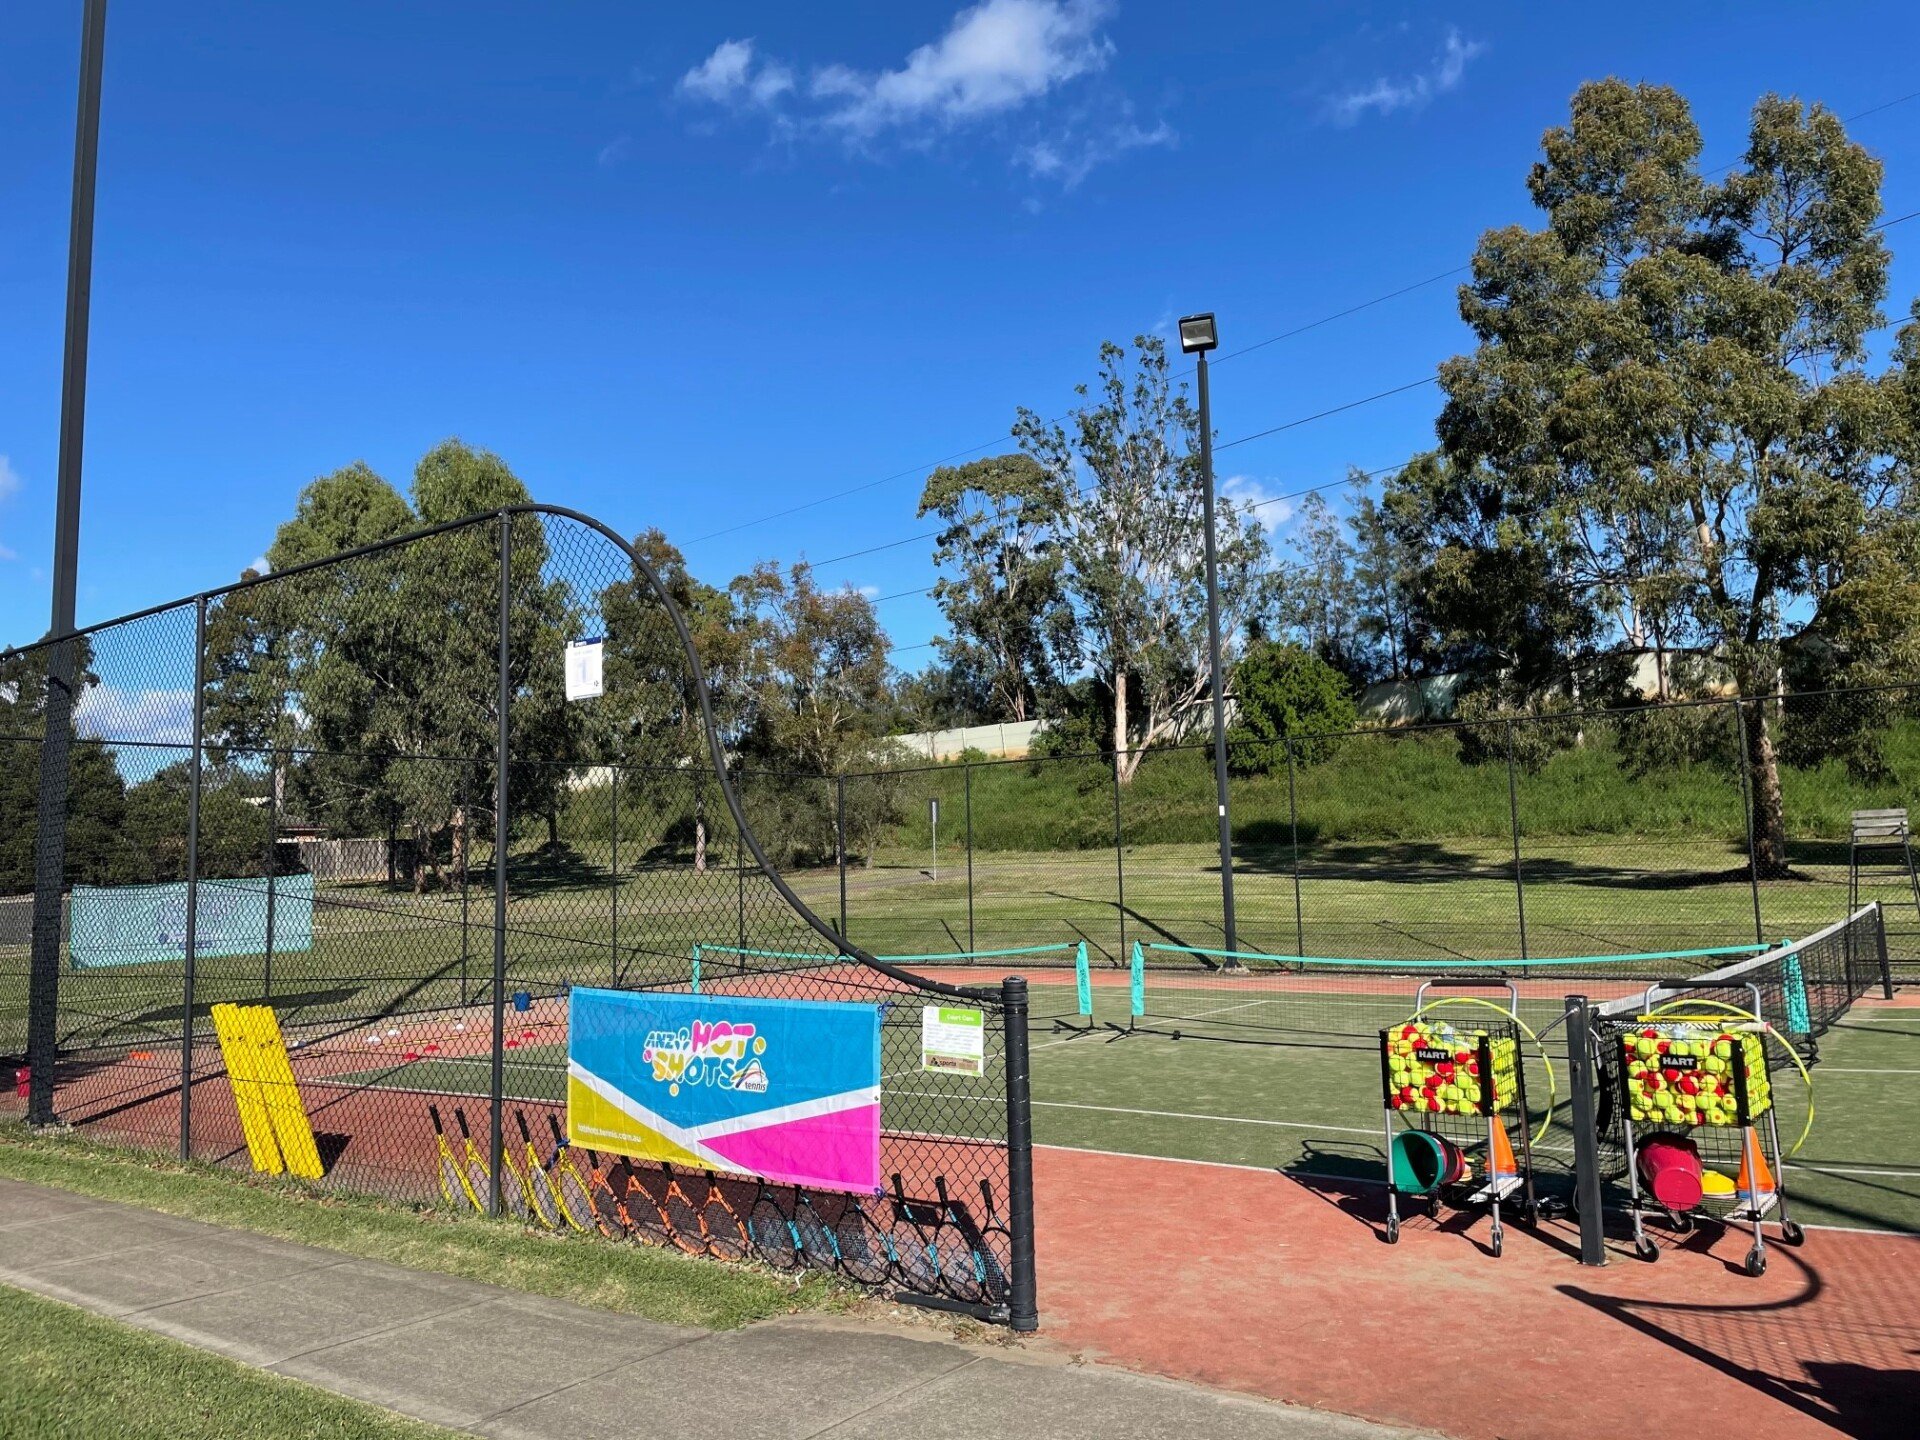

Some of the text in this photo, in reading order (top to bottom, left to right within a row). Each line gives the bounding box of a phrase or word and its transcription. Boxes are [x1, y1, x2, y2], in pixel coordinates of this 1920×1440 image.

[645, 1020, 756, 1059] ANZ HOT
[1418, 1050, 1447, 1060] HART
[1662, 1056, 1695, 1066] HART
[652, 1051, 735, 1089] SHOTS
[745, 1081, 766, 1091] tennis
